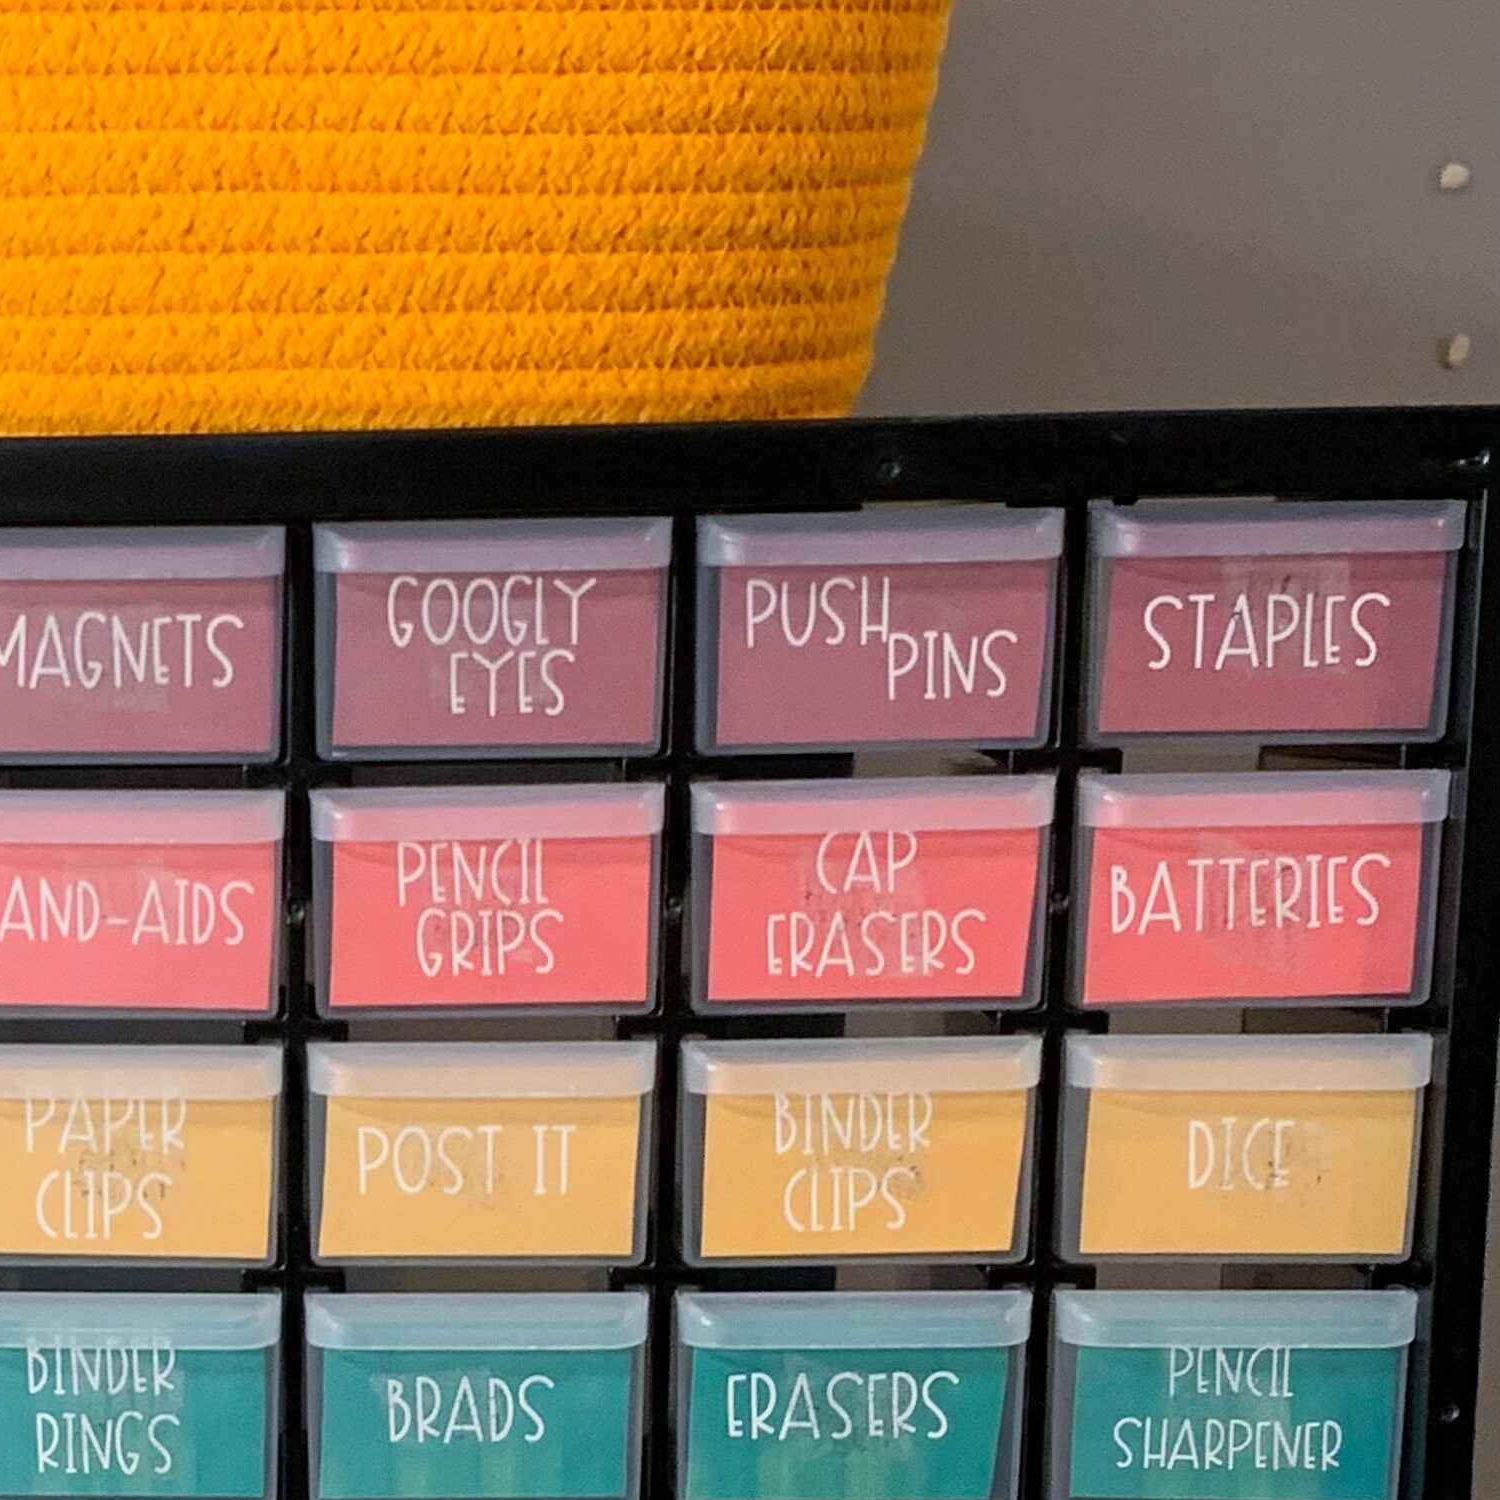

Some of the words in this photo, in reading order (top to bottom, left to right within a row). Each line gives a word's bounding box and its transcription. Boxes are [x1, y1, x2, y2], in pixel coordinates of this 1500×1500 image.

[387, 574, 596, 647] GOOGLY
[747, 576, 890, 649] PUSH
[1144, 593, 1390, 671] STAPLES
[450, 650, 576, 716] EYES
[888, 630, 1018, 700] PINS
[398, 837, 548, 906] PENCIL
[817, 829, 917, 893] CAP
[1111, 853, 1390, 936] BATTERIES
[416, 909, 564, 976] GRIPS
[768, 909, 986, 977] ERASERS
[25, 1087, 185, 1154] PAPER
[775, 1091, 932, 1155] BINDER
[1188, 1118, 1294, 1190] DICE
[358, 1125, 501, 1195] POST
[534, 1125, 576, 1195] IT
[37, 1170, 172, 1240] CLIPS
[784, 1166, 915, 1233] CLIPS
[27, 1337, 177, 1395] BINDER
[1169, 1345, 1295, 1397] PENCIL
[388, 1375, 554, 1443] BRADS
[726, 1370, 959, 1441] ERASERS
[38, 1412, 180, 1474] RINGS
[1113, 1417, 1342, 1471] SHARPENER
